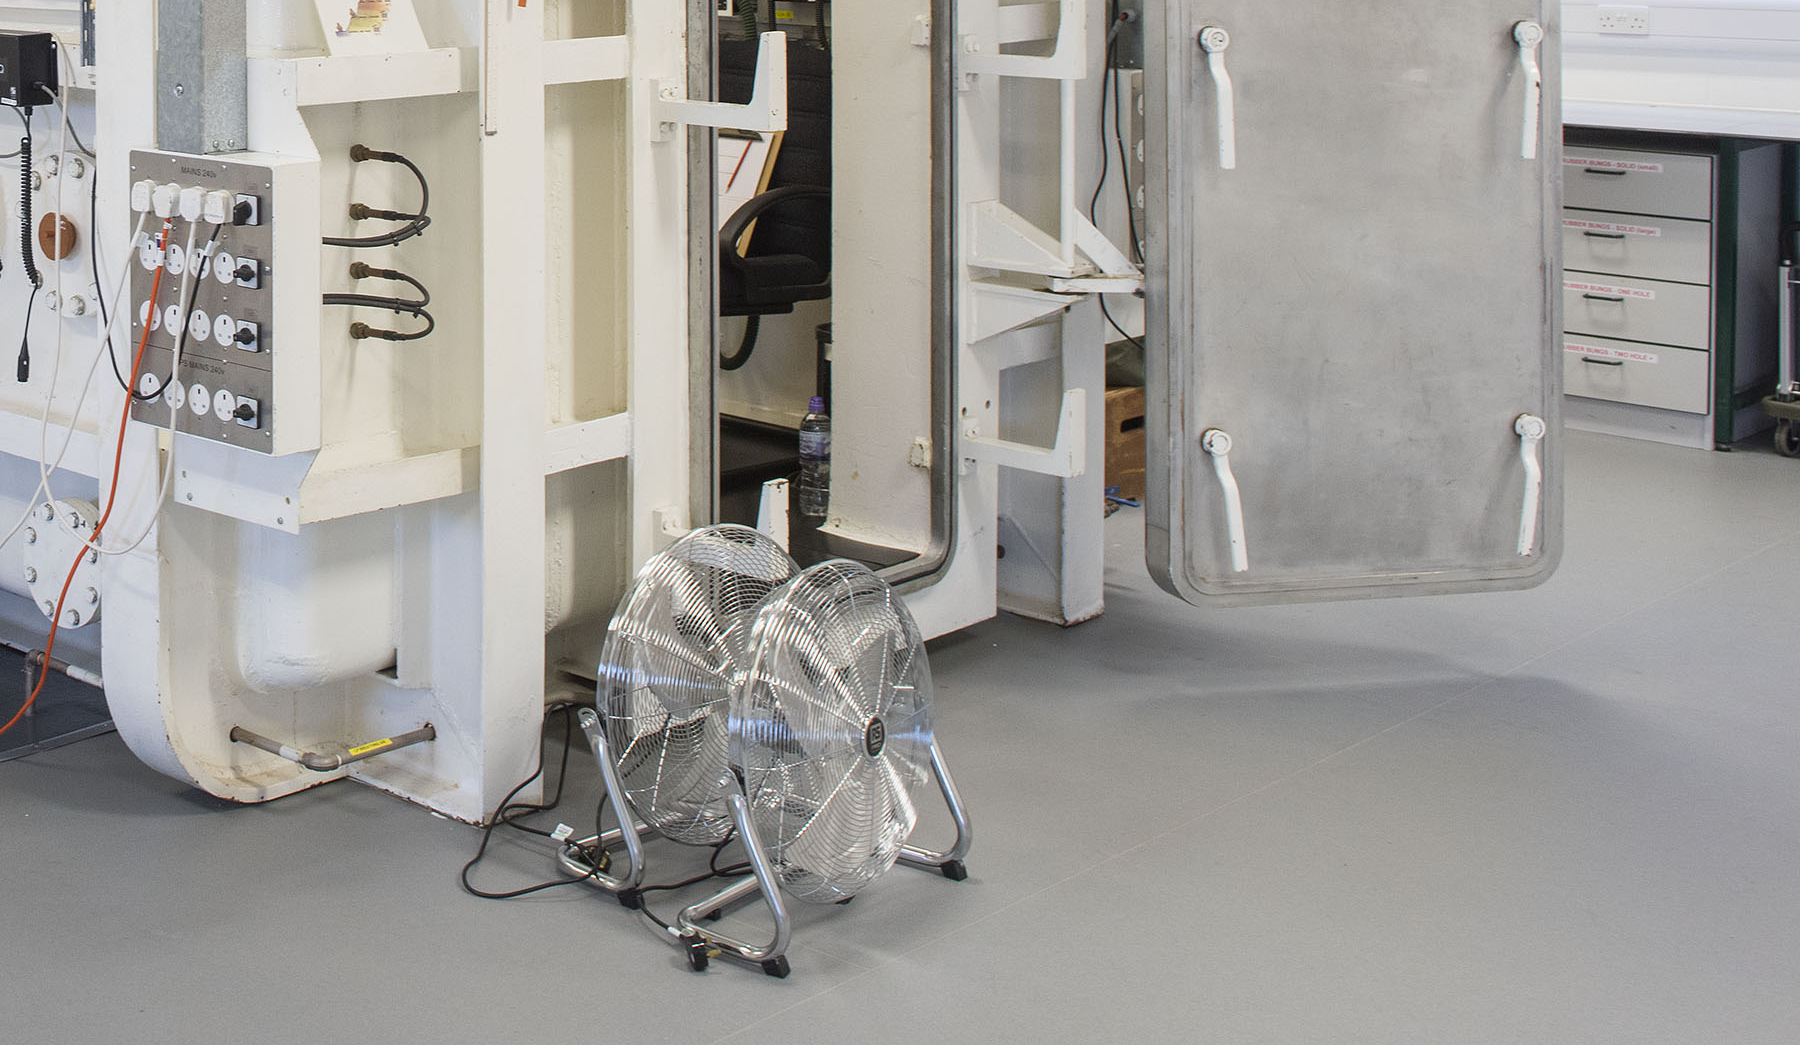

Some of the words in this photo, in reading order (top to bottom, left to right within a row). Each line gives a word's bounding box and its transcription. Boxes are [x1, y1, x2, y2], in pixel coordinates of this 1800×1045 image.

[1589, 160, 1612, 168] BUNGS
[180, 166, 201, 176] MAINS
[1588, 222, 1610, 230] BUNGS
[1590, 285, 1612, 293] BUNGS
[1633, 290, 1651, 298] HOLE
[1586, 347, 1609, 355] BUNGS
[1630, 352, 1647, 361] HOLE
[189, 360, 209, 372] MAINS
